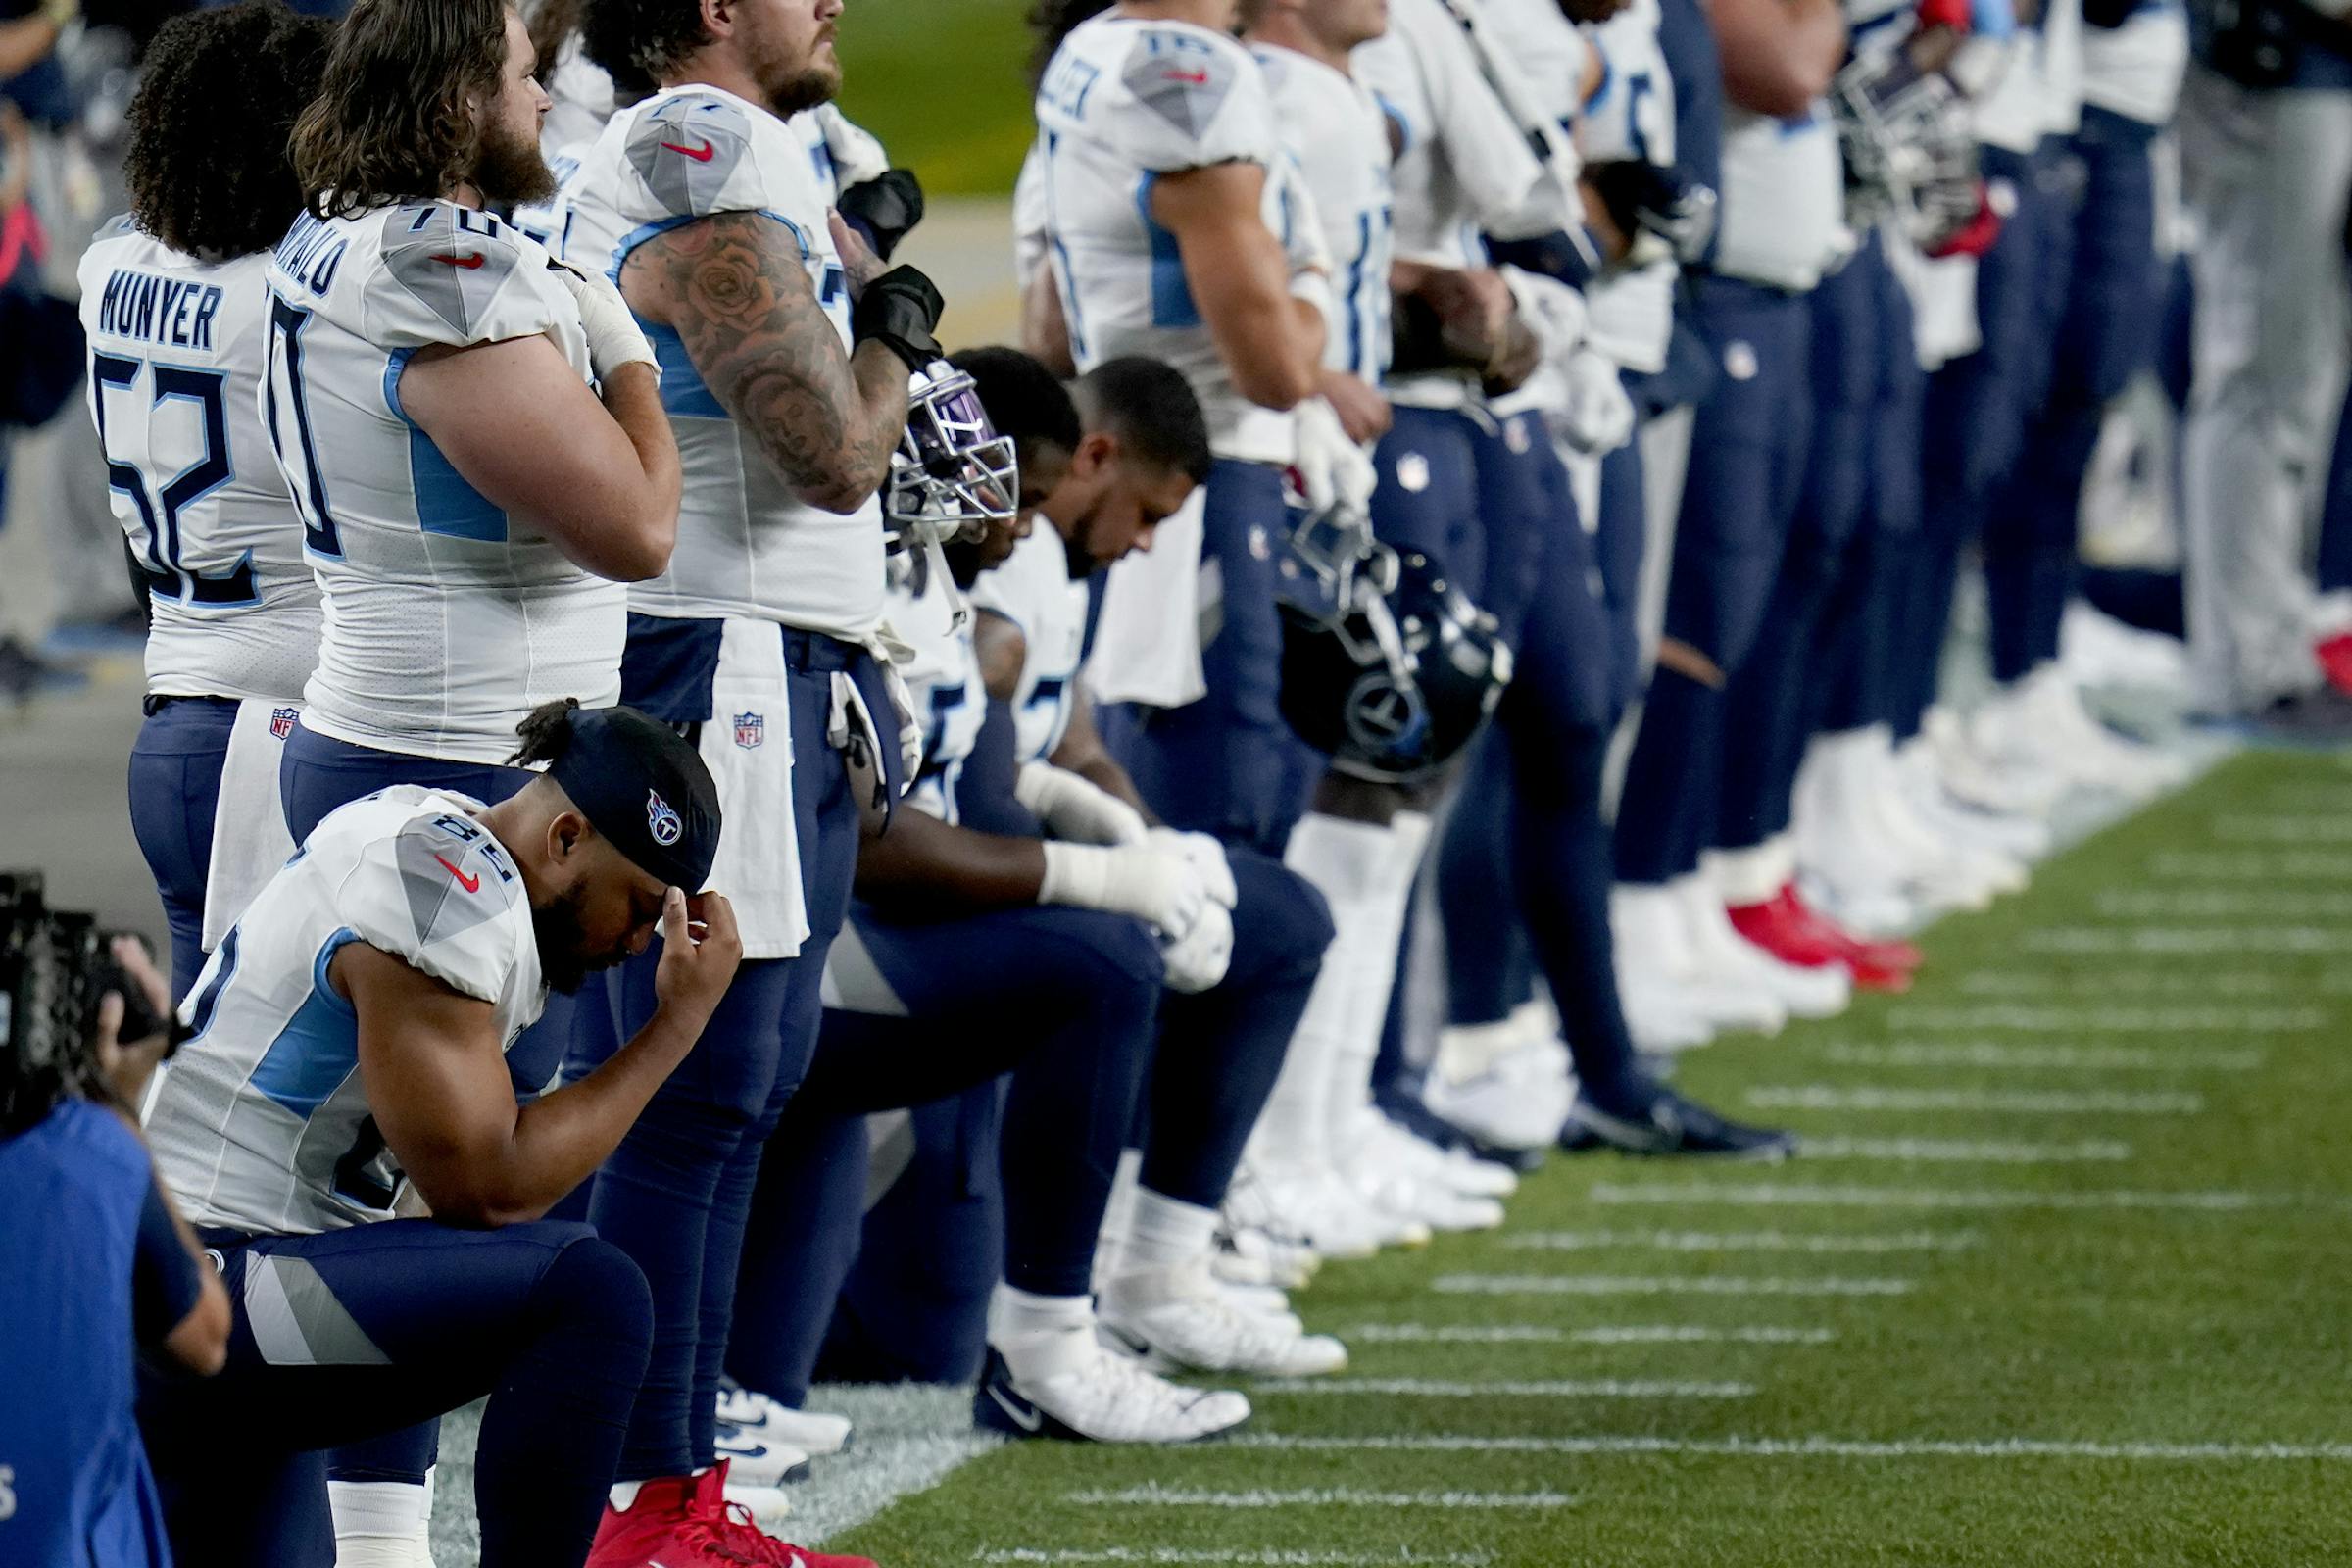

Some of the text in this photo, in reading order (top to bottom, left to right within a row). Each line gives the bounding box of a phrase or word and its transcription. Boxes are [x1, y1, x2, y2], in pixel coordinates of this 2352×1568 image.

[99, 269, 224, 352] MUNYER
[265, 286, 346, 562] 0
[93, 346, 263, 608] 52
